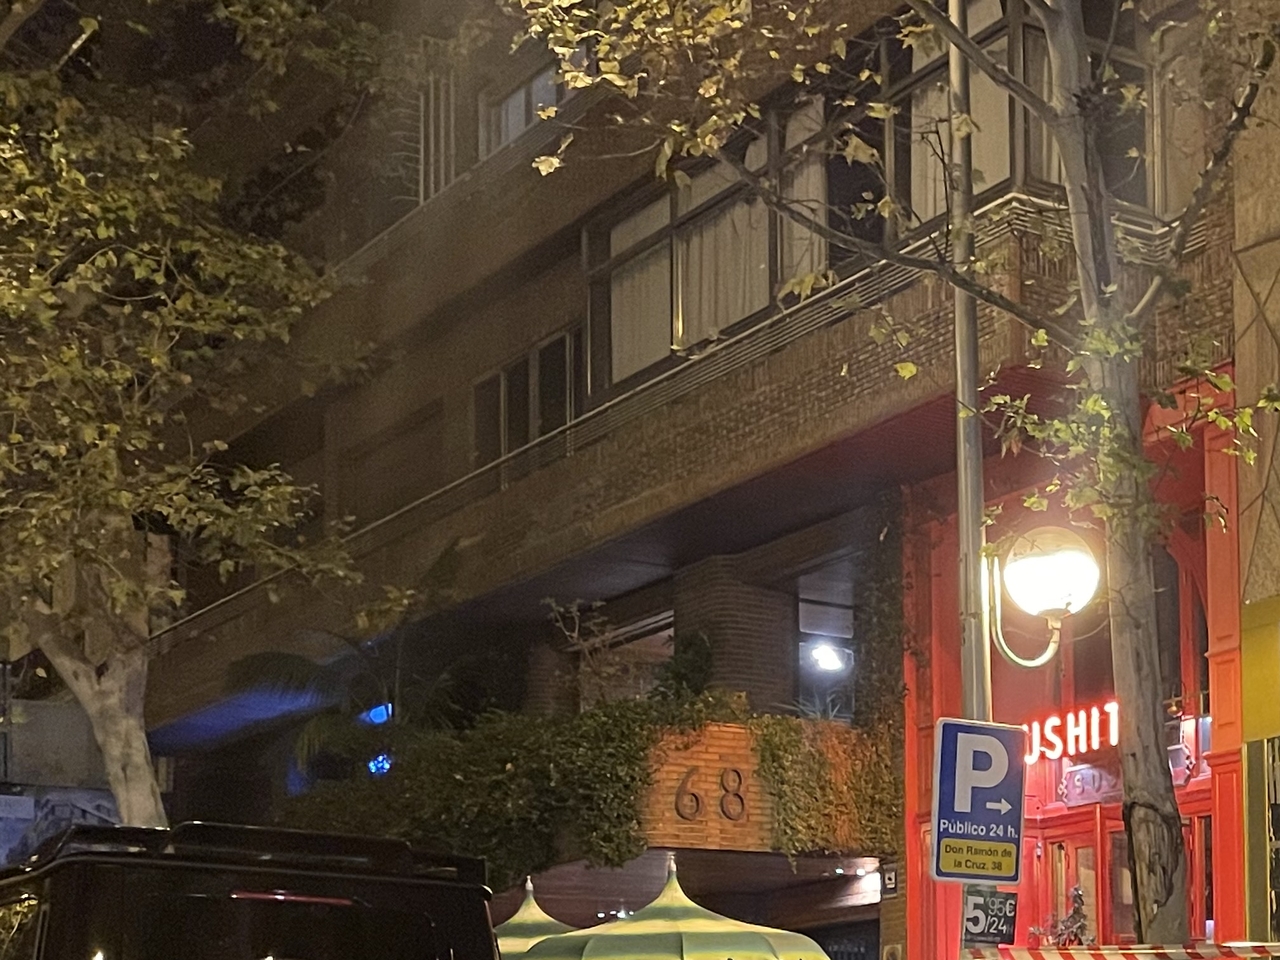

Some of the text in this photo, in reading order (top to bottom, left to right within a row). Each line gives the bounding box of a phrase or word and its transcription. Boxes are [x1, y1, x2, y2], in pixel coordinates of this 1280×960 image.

[954, 732, 1009, 813] P
[673, 767, 746, 821] 68
[940, 819, 1019, 839] Público 24 h.
[945, 844, 1012, 858] Don Ramón de
[954, 859, 963, 868] la
[991, 861, 1003, 871] 38
